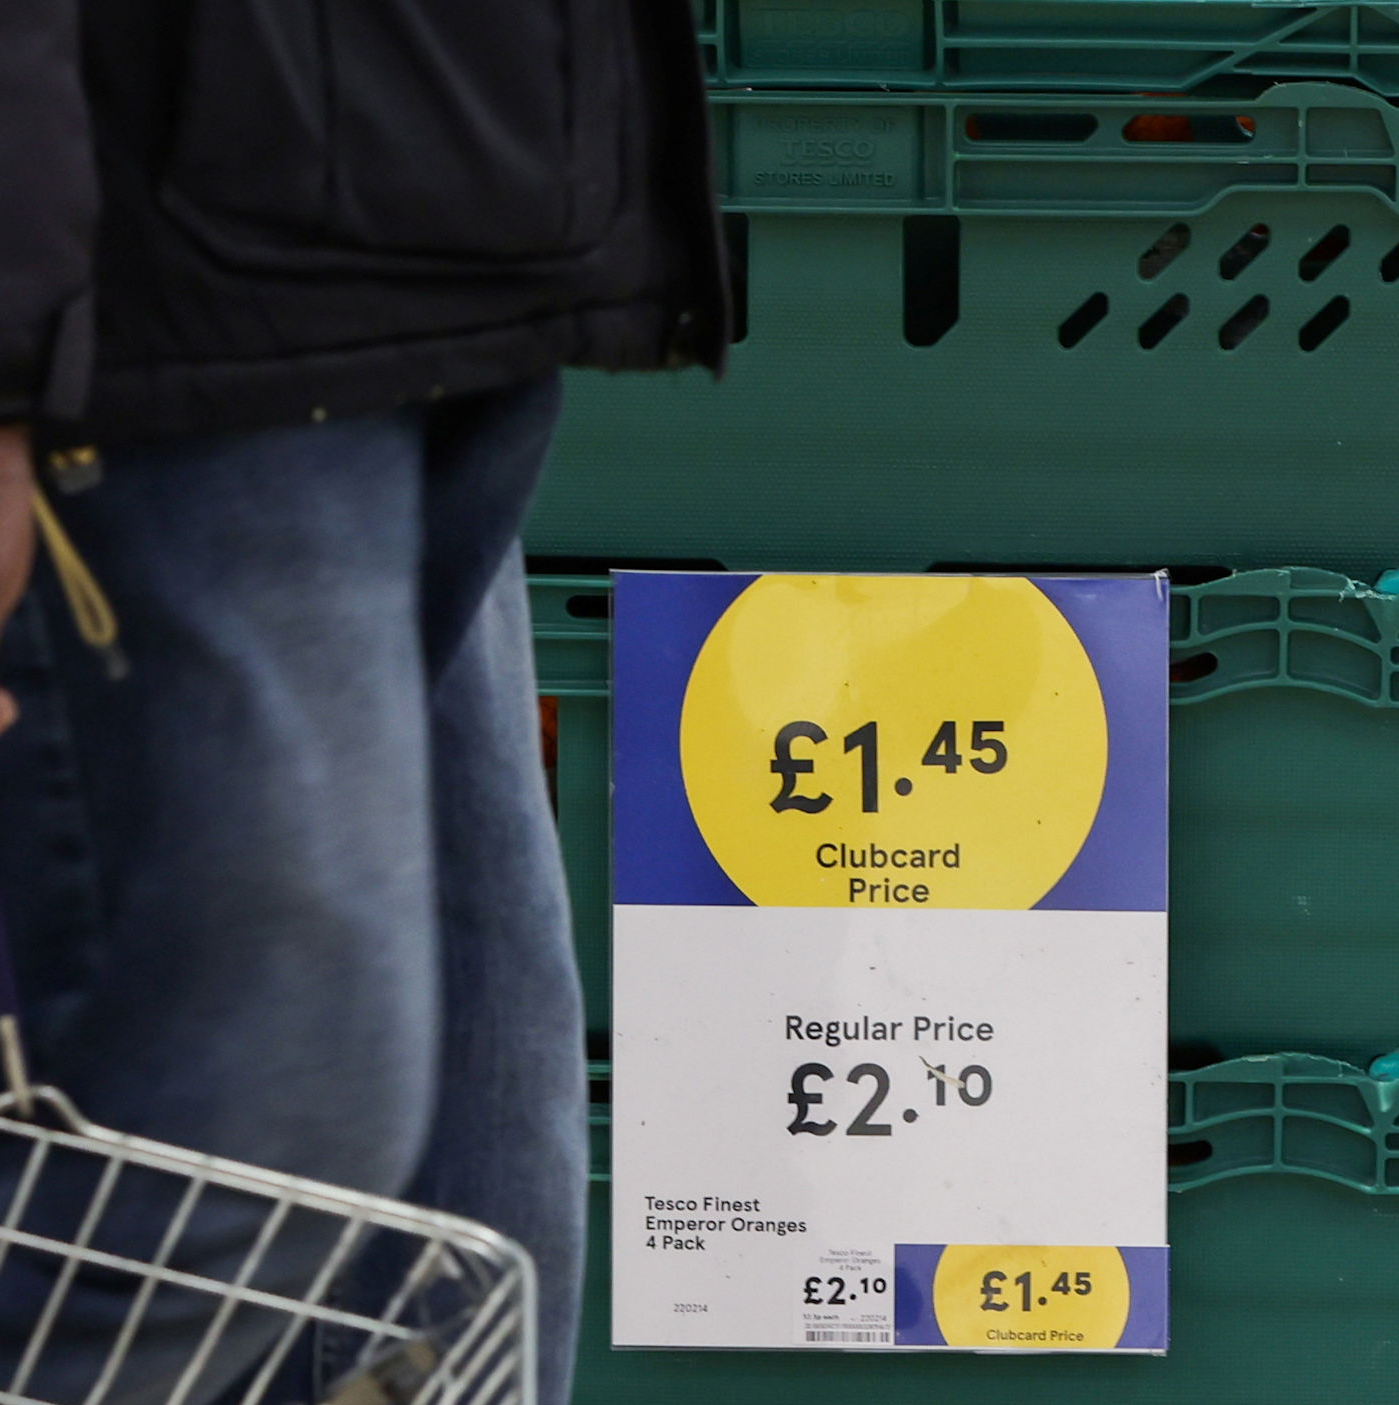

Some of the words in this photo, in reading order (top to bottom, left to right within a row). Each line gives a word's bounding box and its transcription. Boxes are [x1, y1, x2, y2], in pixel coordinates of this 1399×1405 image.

[783, 139, 876, 158] TESCO
[754, 171, 823, 186] STORES
[830, 172, 897, 187] LIMITED
[769, 720, 1009, 815] £1.45
[816, 843, 960, 870] Clubcard
[848, 877, 930, 903] Price
[786, 1015, 903, 1047] Regular
[914, 1016, 994, 1041] Price
[786, 1062, 992, 1136] £2.10
[644, 1196, 697, 1211] Tesco
[703, 1197, 761, 1212] Finest
[646, 1216, 725, 1234] Emperor
[731, 1217, 807, 1236] Oranges
[646, 1235, 656, 1250] 4
[663, 1235, 705, 1250] Pack
[804, 1276, 887, 1305] £2.10
[980, 1270, 1092, 1312] £1.45
[986, 1329, 1046, 1341] Clubcard
[1050, 1330, 1084, 1342] Price
